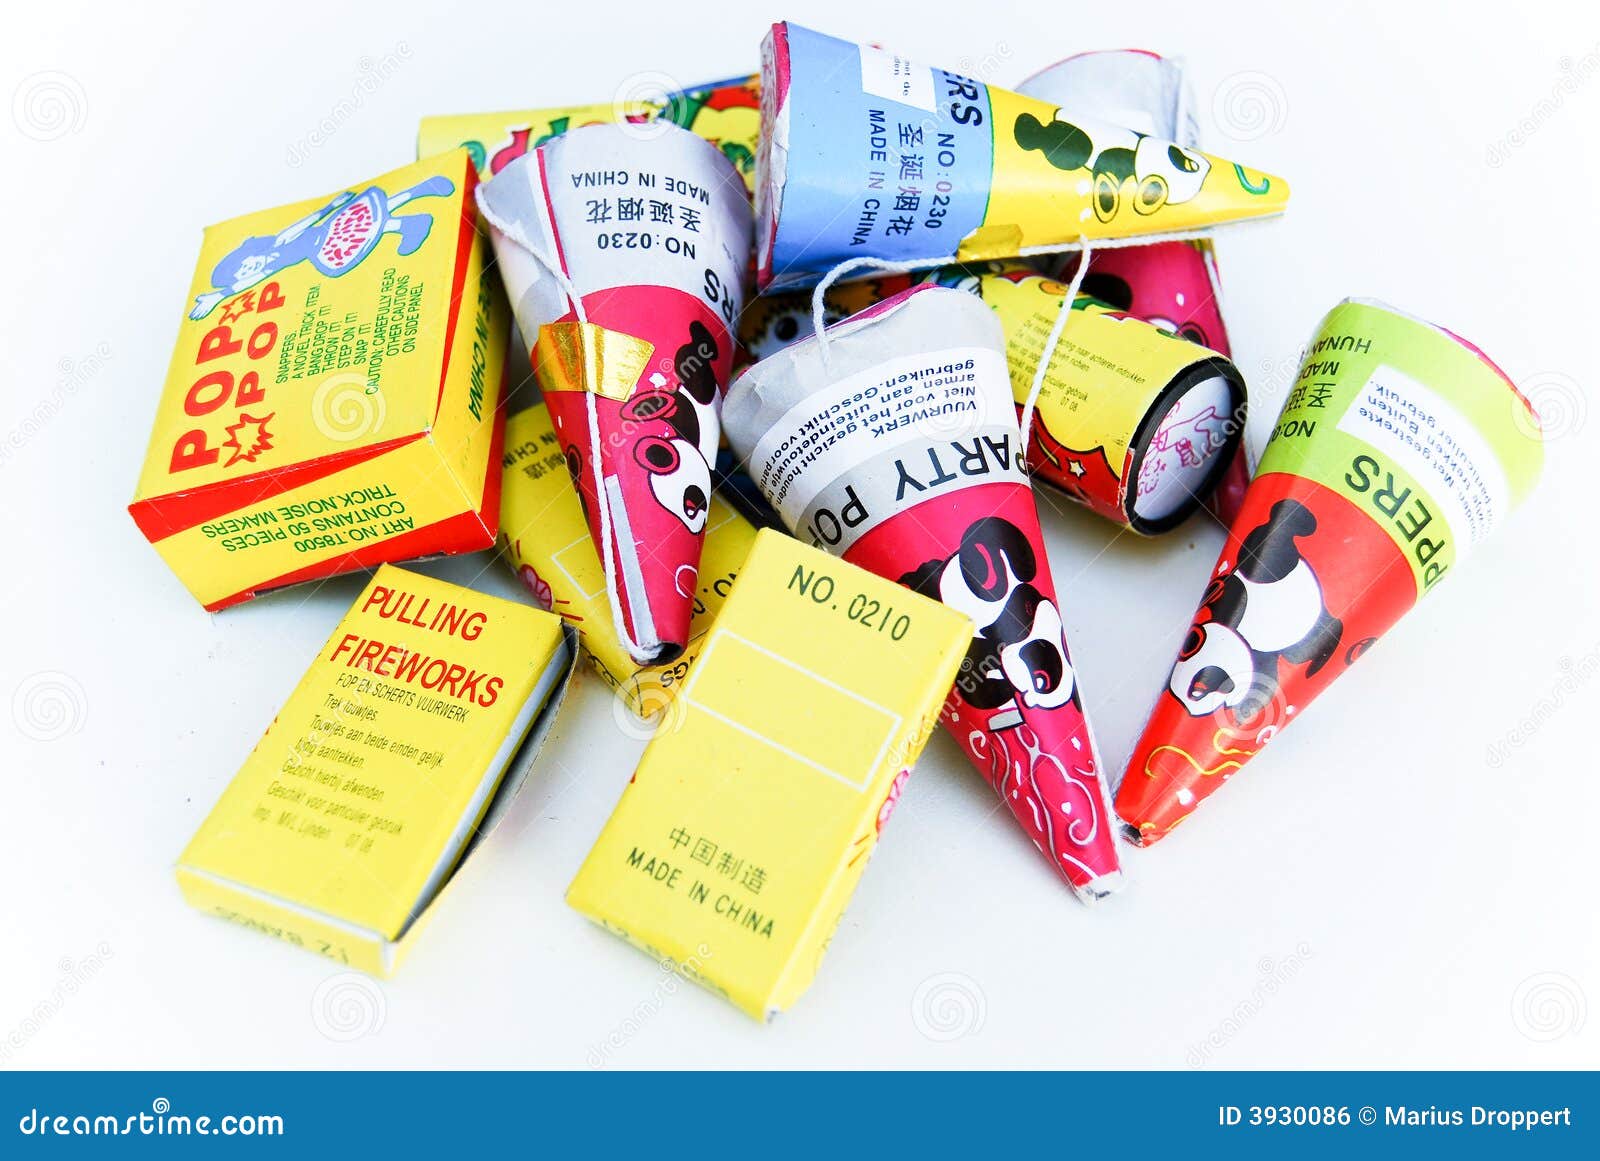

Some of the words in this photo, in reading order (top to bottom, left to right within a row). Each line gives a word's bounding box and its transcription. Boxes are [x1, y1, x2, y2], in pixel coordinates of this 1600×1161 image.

[943, 70, 983, 127] RS
[868, 108, 887, 162] MADE
[571, 171, 629, 189] CHINA
[639, 172, 655, 188] IN
[664, 176, 710, 206] MADE
[868, 171, 884, 190] IN
[885, 123, 924, 236] 圣诞烟花
[925, 133, 955, 229] NO:0230
[586, 198, 701, 233] 圣诞烟花
[849, 199, 880, 247] CHINA
[381, 268, 396, 293] READ
[319, 304, 332, 316] IT!
[391, 275, 410, 322] CAUTIONS
[408, 282, 424, 313] PANEL
[704, 268, 737, 326] RS
[299, 309, 316, 338] TRICK
[329, 321, 342, 333] IT!
[345, 312, 358, 323] IT!
[358, 323, 372, 335] IT!
[372, 295, 392, 346] CAREFULLY
[405, 313, 420, 336] SIDE
[235, 281, 286, 409] POP
[313, 321, 328, 347] DROP
[342, 326, 355, 342] ON
[386, 322, 403, 357] OTHER
[402, 338, 416, 353] ON
[294, 338, 310, 372] NOVEL
[307, 347, 324, 376] BANG
[322, 336, 339, 373] THROW
[337, 345, 352, 369] STEP
[353, 339, 369, 365] SNAP
[468, 341, 486, 423] CHINA
[923, 373, 975, 389] armen
[1299, 361, 1340, 379] MAD
[169, 325, 244, 474] POP
[880, 385, 913, 403] aan
[896, 393, 935, 412] voor
[944, 386, 976, 399] Niet
[862, 408, 890, 427] het
[871, 400, 977, 439] VUURWERK
[1367, 395, 1419, 435] Buiten
[800, 421, 858, 468] gezicht
[1359, 407, 1431, 459] gestrekte
[502, 441, 539, 469] CHIN
[770, 436, 798, 464] voor
[201, 510, 278, 539] MAKERS
[288, 521, 311, 537] 50
[312, 500, 406, 533] CONTAINS
[1345, 454, 1448, 594] PPERS
[221, 527, 288, 552] PIECES
[361, 585, 488, 641] PULLING
[787, 564, 837, 611] NO.
[848, 593, 911, 641] 0210
[330, 633, 504, 708] FIREWORKS
[323, 693, 342, 710] Trek
[336, 672, 358, 688] FOP
[371, 683, 417, 709] SCHERTS
[416, 695, 470, 724] VUURWERK
[345, 728, 364, 742] aan
[363, 731, 389, 750] beide
[389, 738, 419, 759] einden
[668, 826, 768, 896] 中国制造
[625, 847, 682, 890] MADE
[688, 880, 711, 905] IN
[713, 895, 774, 940] CHINA
